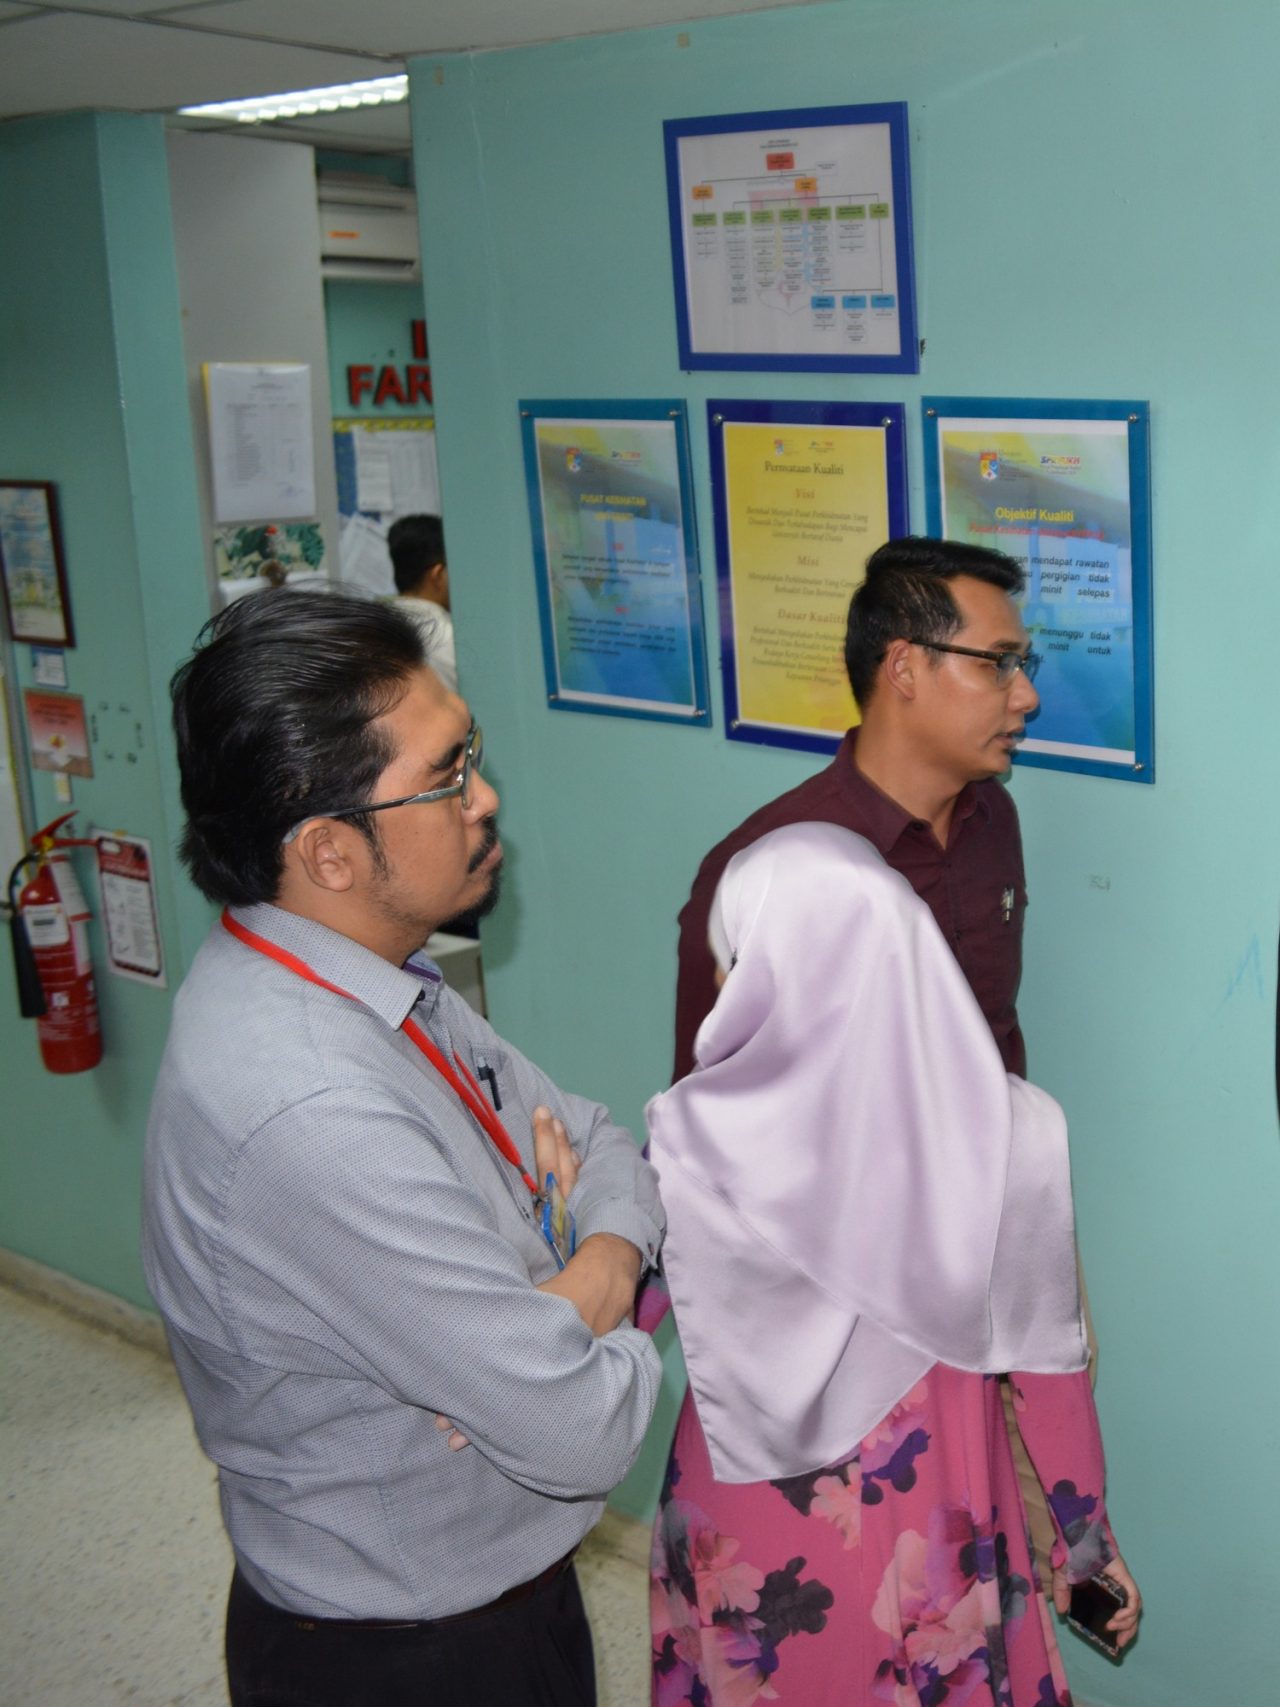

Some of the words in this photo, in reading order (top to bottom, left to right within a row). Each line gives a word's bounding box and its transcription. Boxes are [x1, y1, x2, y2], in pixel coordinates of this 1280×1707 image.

[995, 507, 1037, 522] Objektif
[1039, 509, 1074, 522] Kualiti
[1031, 556, 1073, 567] mendapat
[1075, 559, 1110, 568] rawatan
[1040, 571, 1080, 582] pergigian
[1088, 573, 1110, 583] tidak
[1040, 586, 1063, 594] minit
[1078, 587, 1110, 599] selepas
[1040, 627, 1085, 639] menunggu
[1090, 631, 1112, 641] tidak
[1048, 642, 1070, 651] minit
[1087, 646, 1112, 655] untuk
